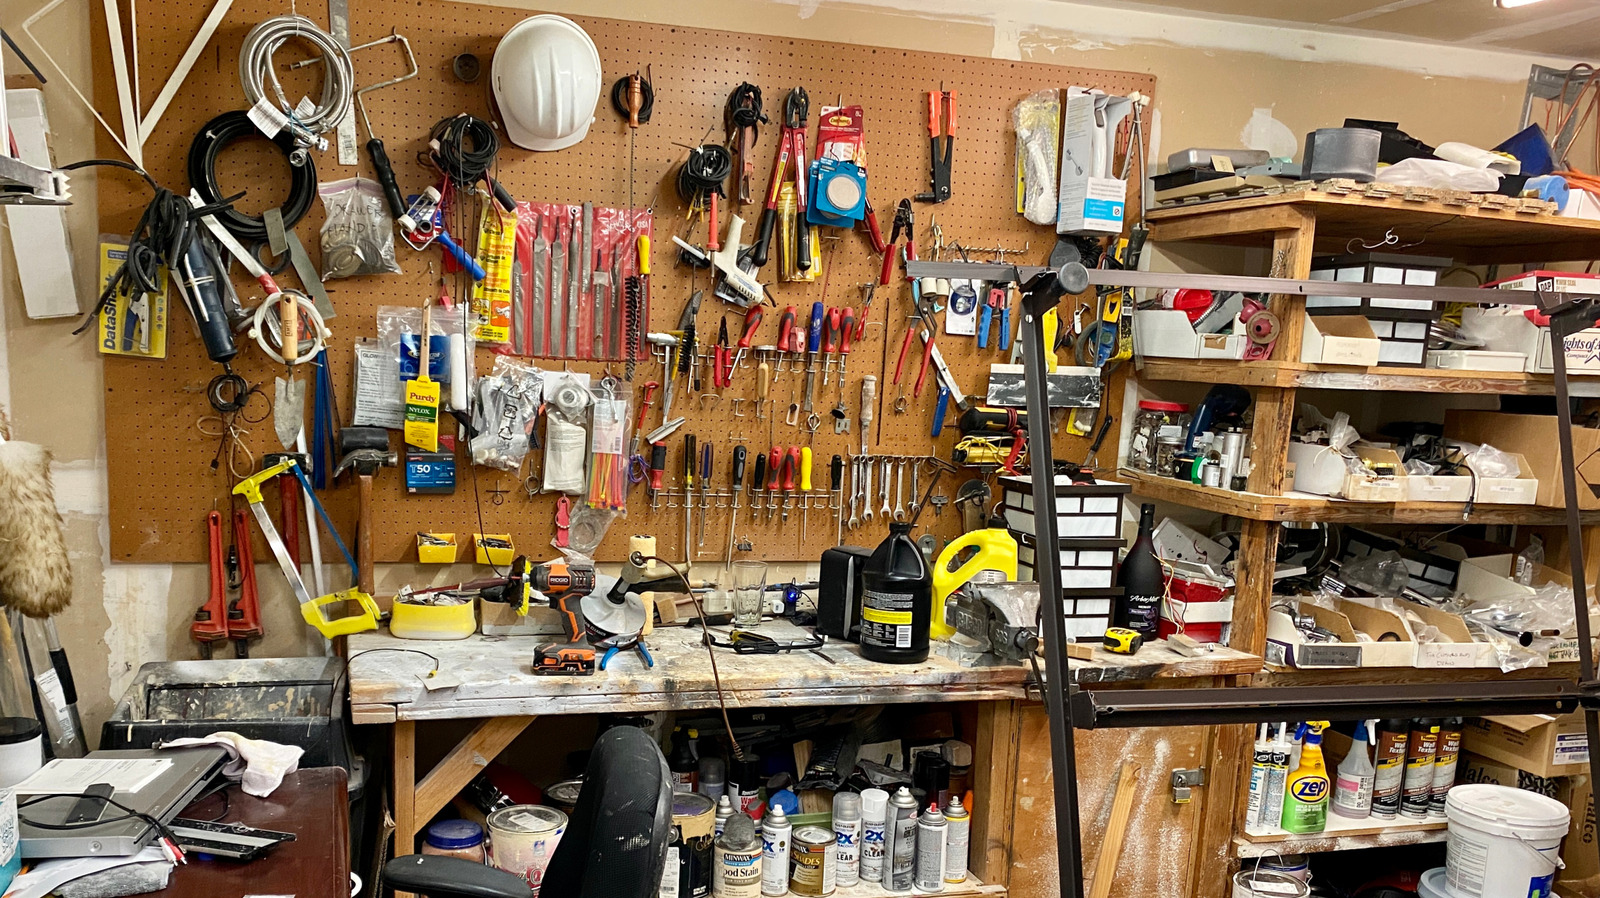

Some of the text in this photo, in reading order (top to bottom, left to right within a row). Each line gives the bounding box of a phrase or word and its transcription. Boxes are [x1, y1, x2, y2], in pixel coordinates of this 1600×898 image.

[1540, 281, 1552, 292] DAP
[103, 270, 118, 351] DataShak
[1563, 337, 1585, 352] ights
[409, 392, 436, 403] Purdy
[408, 406, 431, 415] NYLOX
[410, 464, 431, 474] T50
[550, 576, 569, 584] RIDGID
[865, 829, 885, 841] 2X
[725, 853, 751, 862] MINWAX
[724, 866, 759, 878] ood Stain
